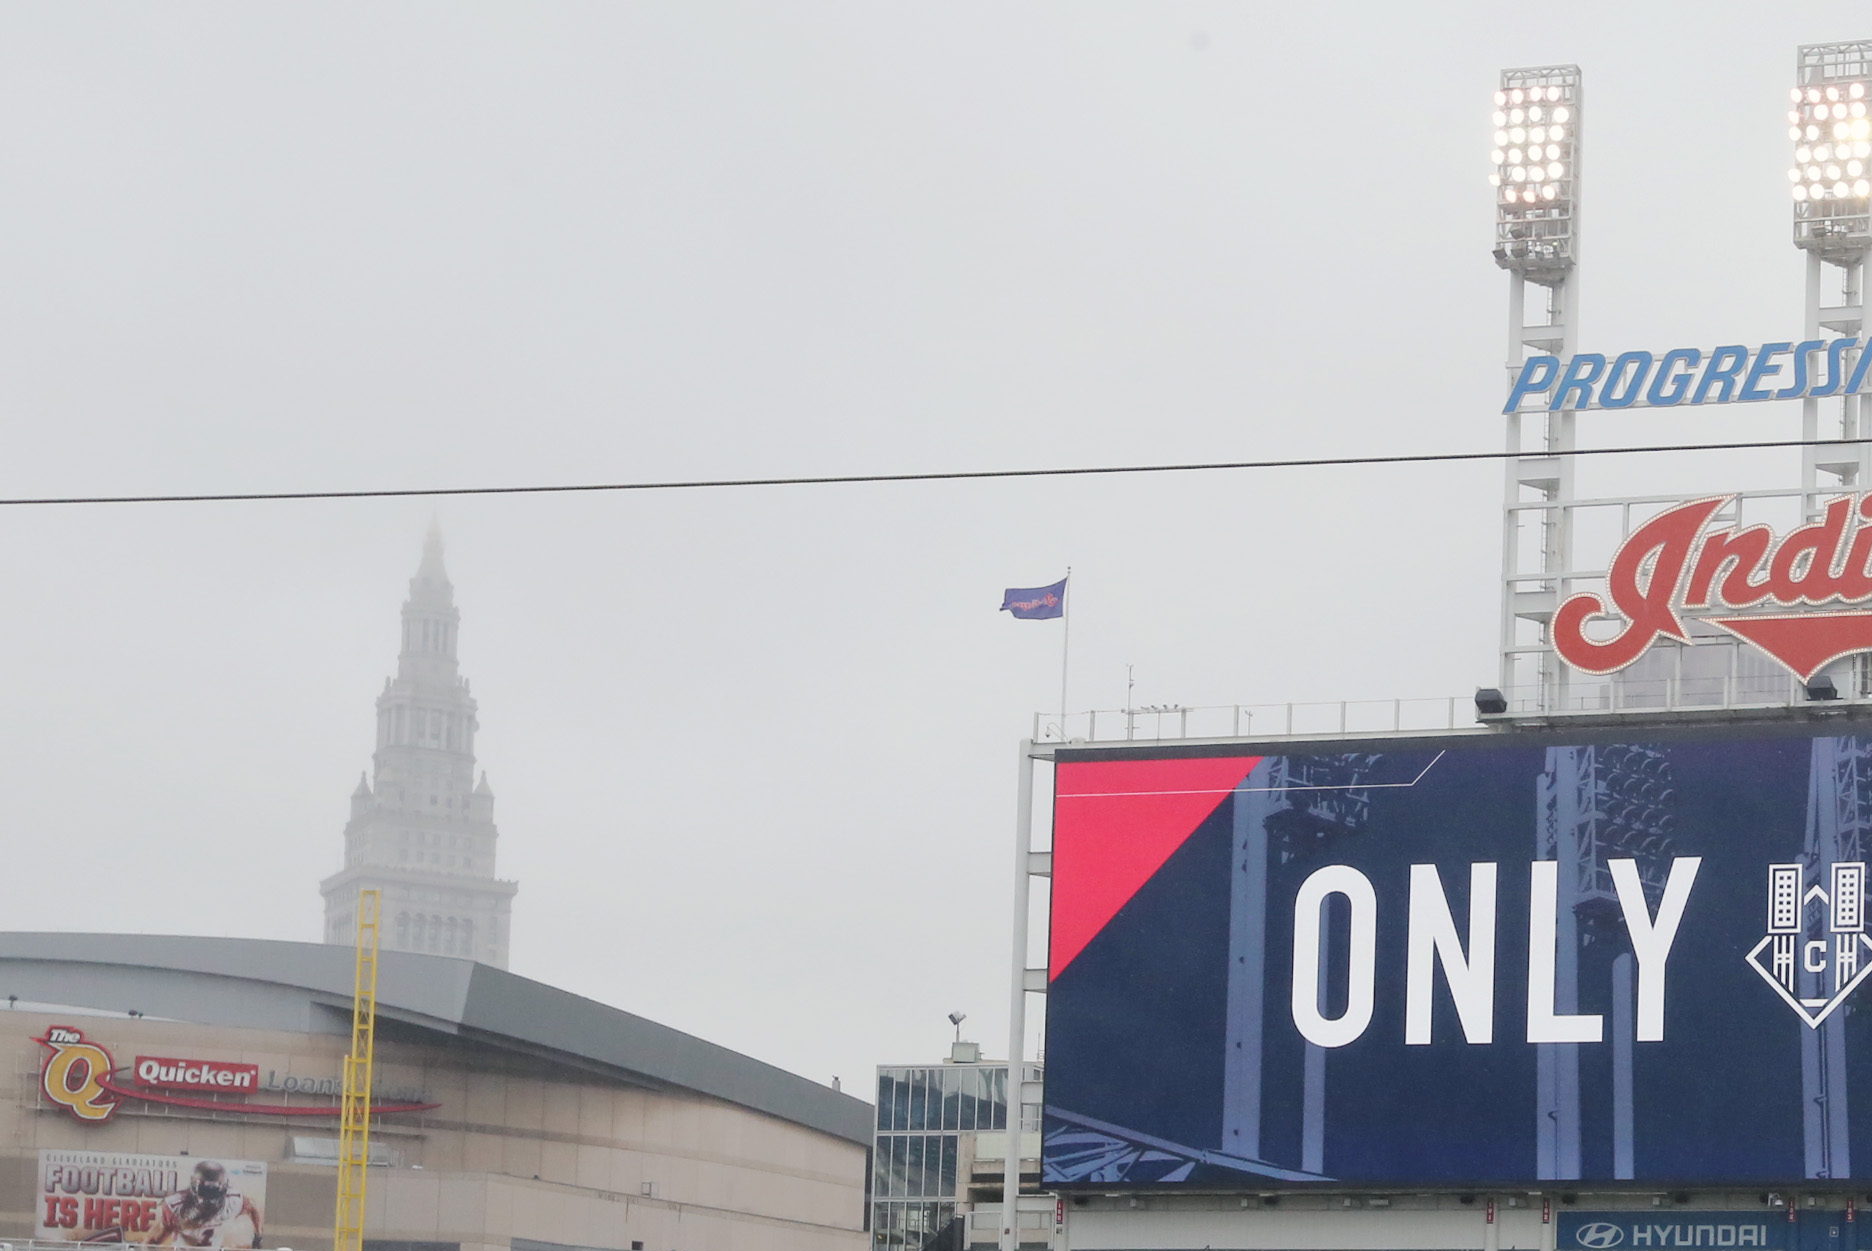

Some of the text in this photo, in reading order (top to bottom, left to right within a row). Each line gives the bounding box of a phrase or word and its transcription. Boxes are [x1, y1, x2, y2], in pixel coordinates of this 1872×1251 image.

[1292, 856, 1702, 1048] ONLY
[50, 1028, 80, 1043] The
[43, 1041, 116, 1120] Q
[138, 1060, 251, 1088] Quicken
[46, 1153, 106, 1165] CLEVELAND
[45, 1164, 178, 1198] FOOTBALL
[43, 1195, 158, 1232] IS HERE
[1633, 1225, 1767, 1246] HYUNDAI
